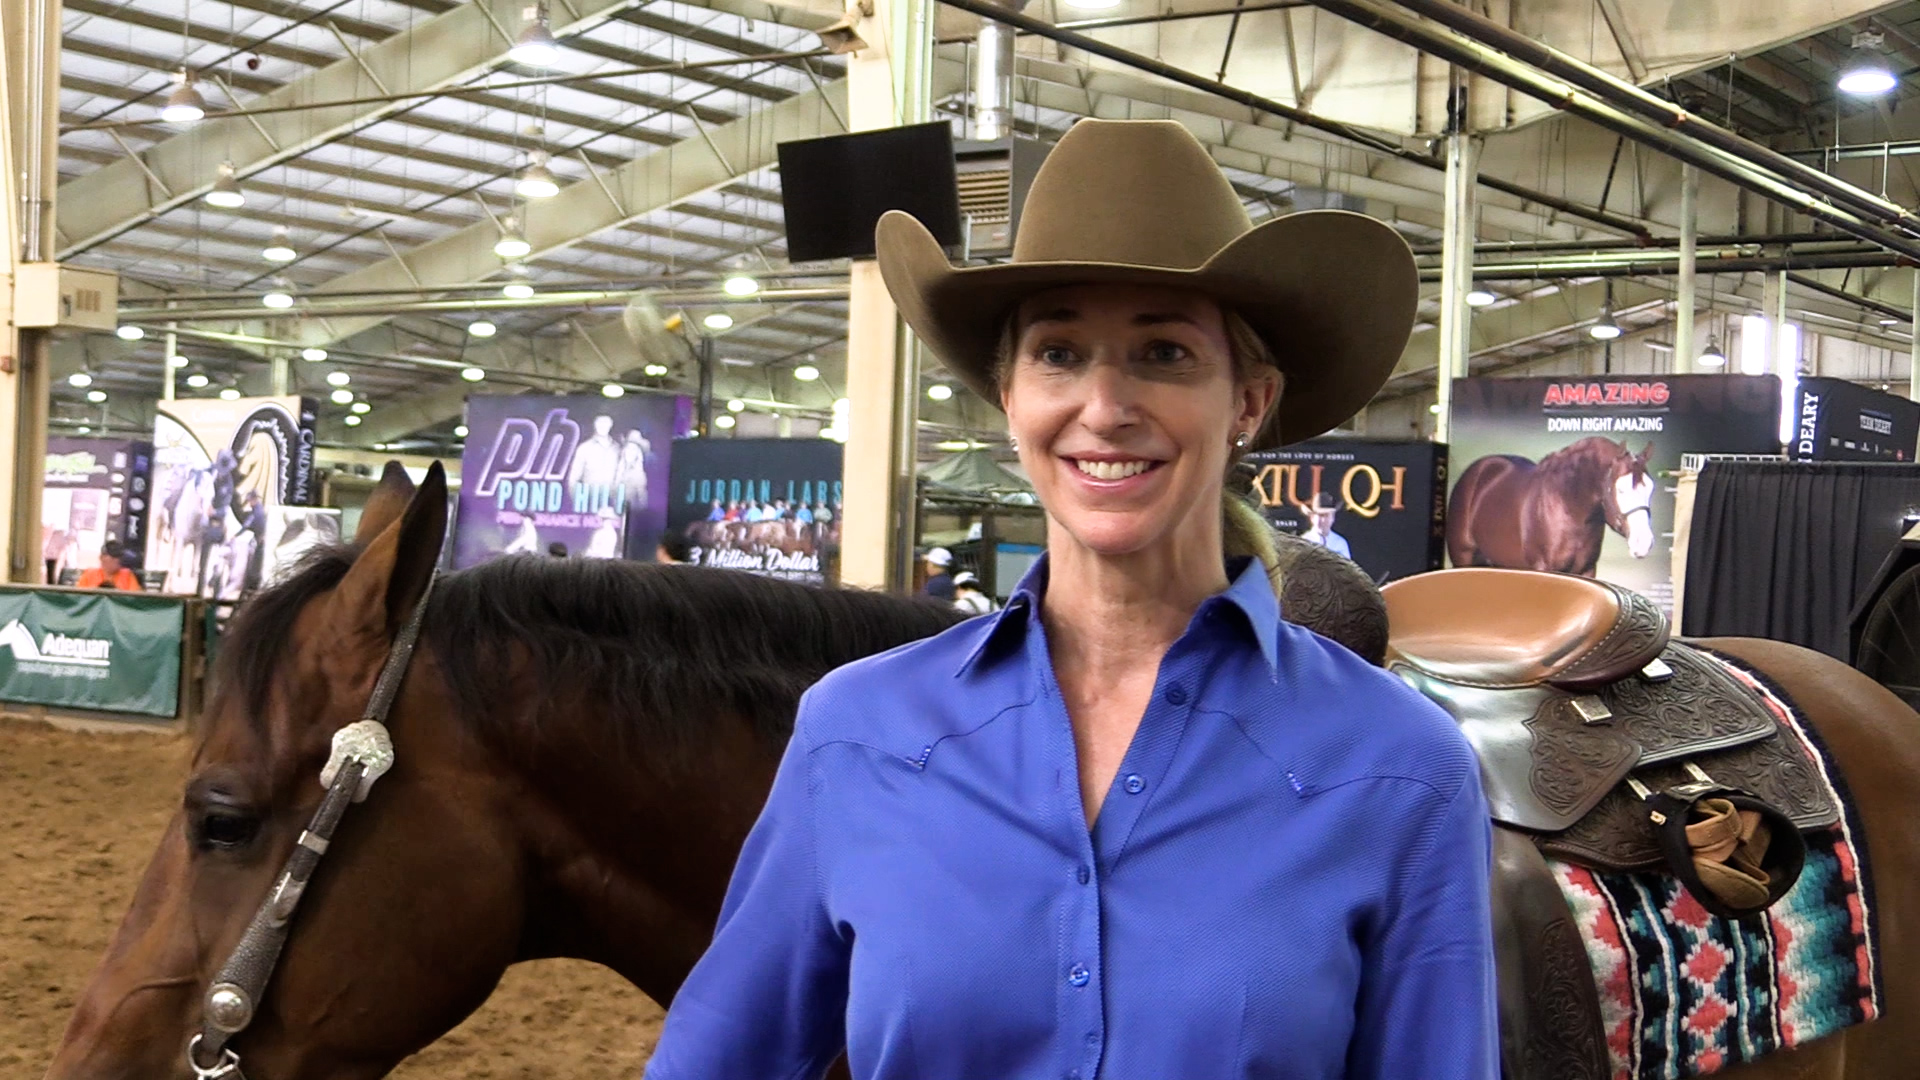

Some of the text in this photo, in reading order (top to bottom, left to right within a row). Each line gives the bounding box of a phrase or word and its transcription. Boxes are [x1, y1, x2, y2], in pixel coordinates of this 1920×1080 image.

[1543, 382, 1670, 405] AMAZING
[1548, 416, 1663, 432] DOWN RIGHT AMAZING
[1798, 391, 1819, 454] DEARY
[497, 480, 563, 512] POND
[686, 479, 770, 504] JORDAN
[1342, 464, 1408, 518] QH
[706, 548, 764, 570] Million
[766, 548, 821, 573] Dollar
[41, 633, 110, 659] Adequan
